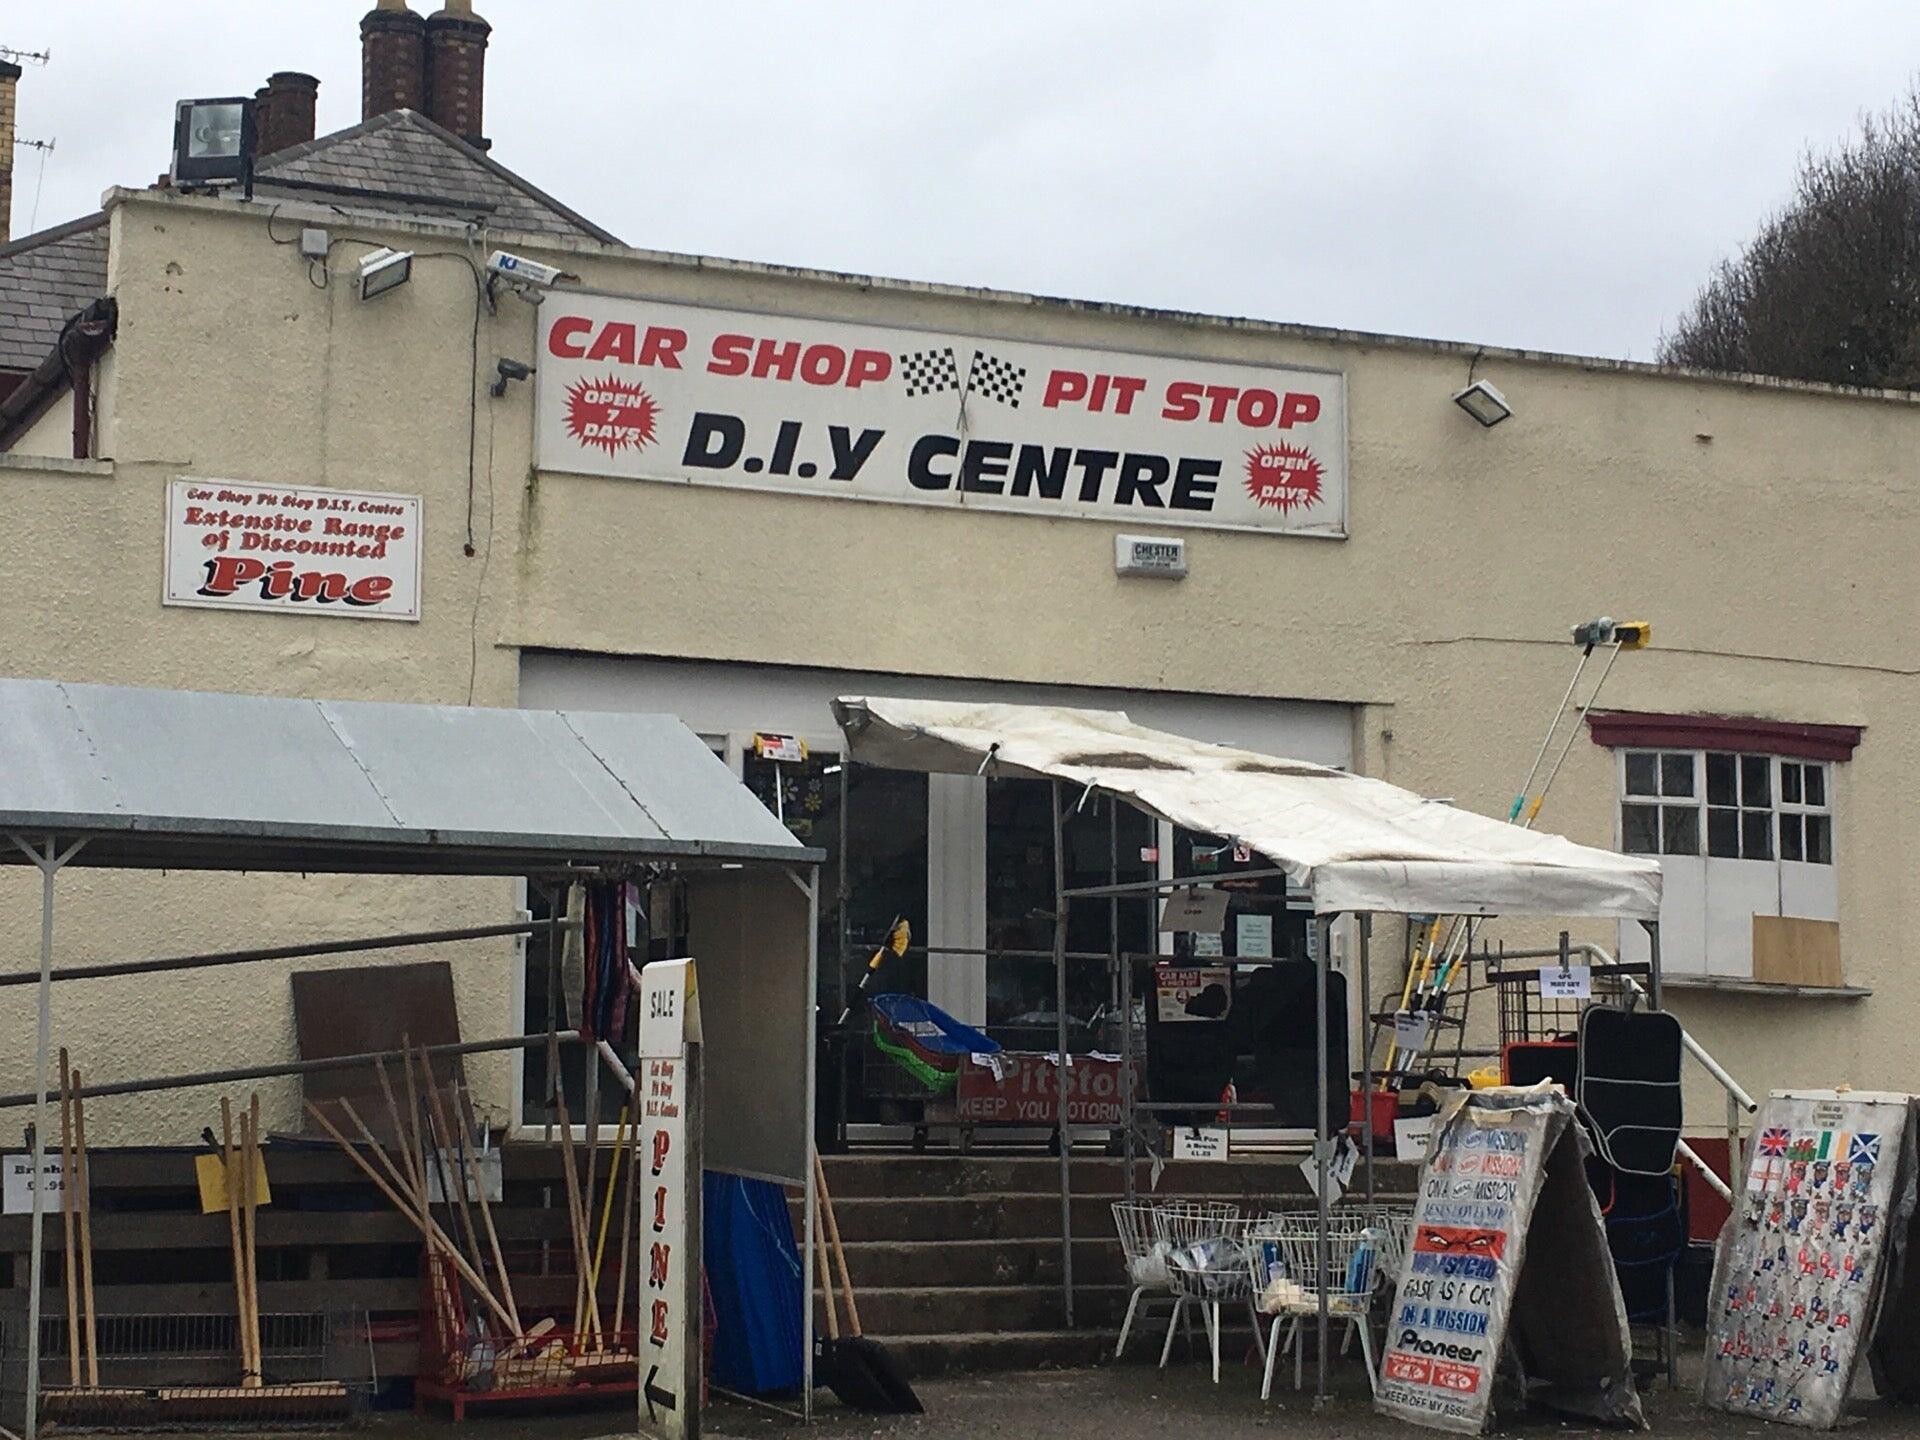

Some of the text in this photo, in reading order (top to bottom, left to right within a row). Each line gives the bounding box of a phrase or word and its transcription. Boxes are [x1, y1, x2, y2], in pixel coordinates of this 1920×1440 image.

[548, 316, 893, 389] CAR SHOP
[584, 389, 643, 409] OPEN
[1043, 369, 1321, 430] PIT STOP
[606, 408, 620, 422] 7
[583, 422, 642, 442] DAYS
[682, 411, 1223, 512] D.I.Y CENTRE
[1260, 454, 1311, 471] OPEN
[1280, 471, 1291, 484] 7
[1261, 485, 1310, 502] DAYS
[183, 506, 405, 542] Extensive Range
[201, 530, 387, 560] of Discounted
[1134, 543, 1179, 557] CHESTER
[197, 556, 394, 606] Pine
[651, 989, 675, 1019] SALE
[959, 1096, 1008, 1116] KEEP
[1016, 1101, 1050, 1119] YOU
[27, 1181, 66, 1191] £.99
[1474, 1181, 1517, 1201] MISSION
[1420, 1307, 1429, 1326] A
[1434, 1308, 1488, 1335] MISSION
[1397, 1329, 1482, 1362] Pioneer
[1384, 1391, 1408, 1403] KEEP
[1409, 1395, 1426, 1407] OFF
[1429, 1399, 1442, 1411] MY
